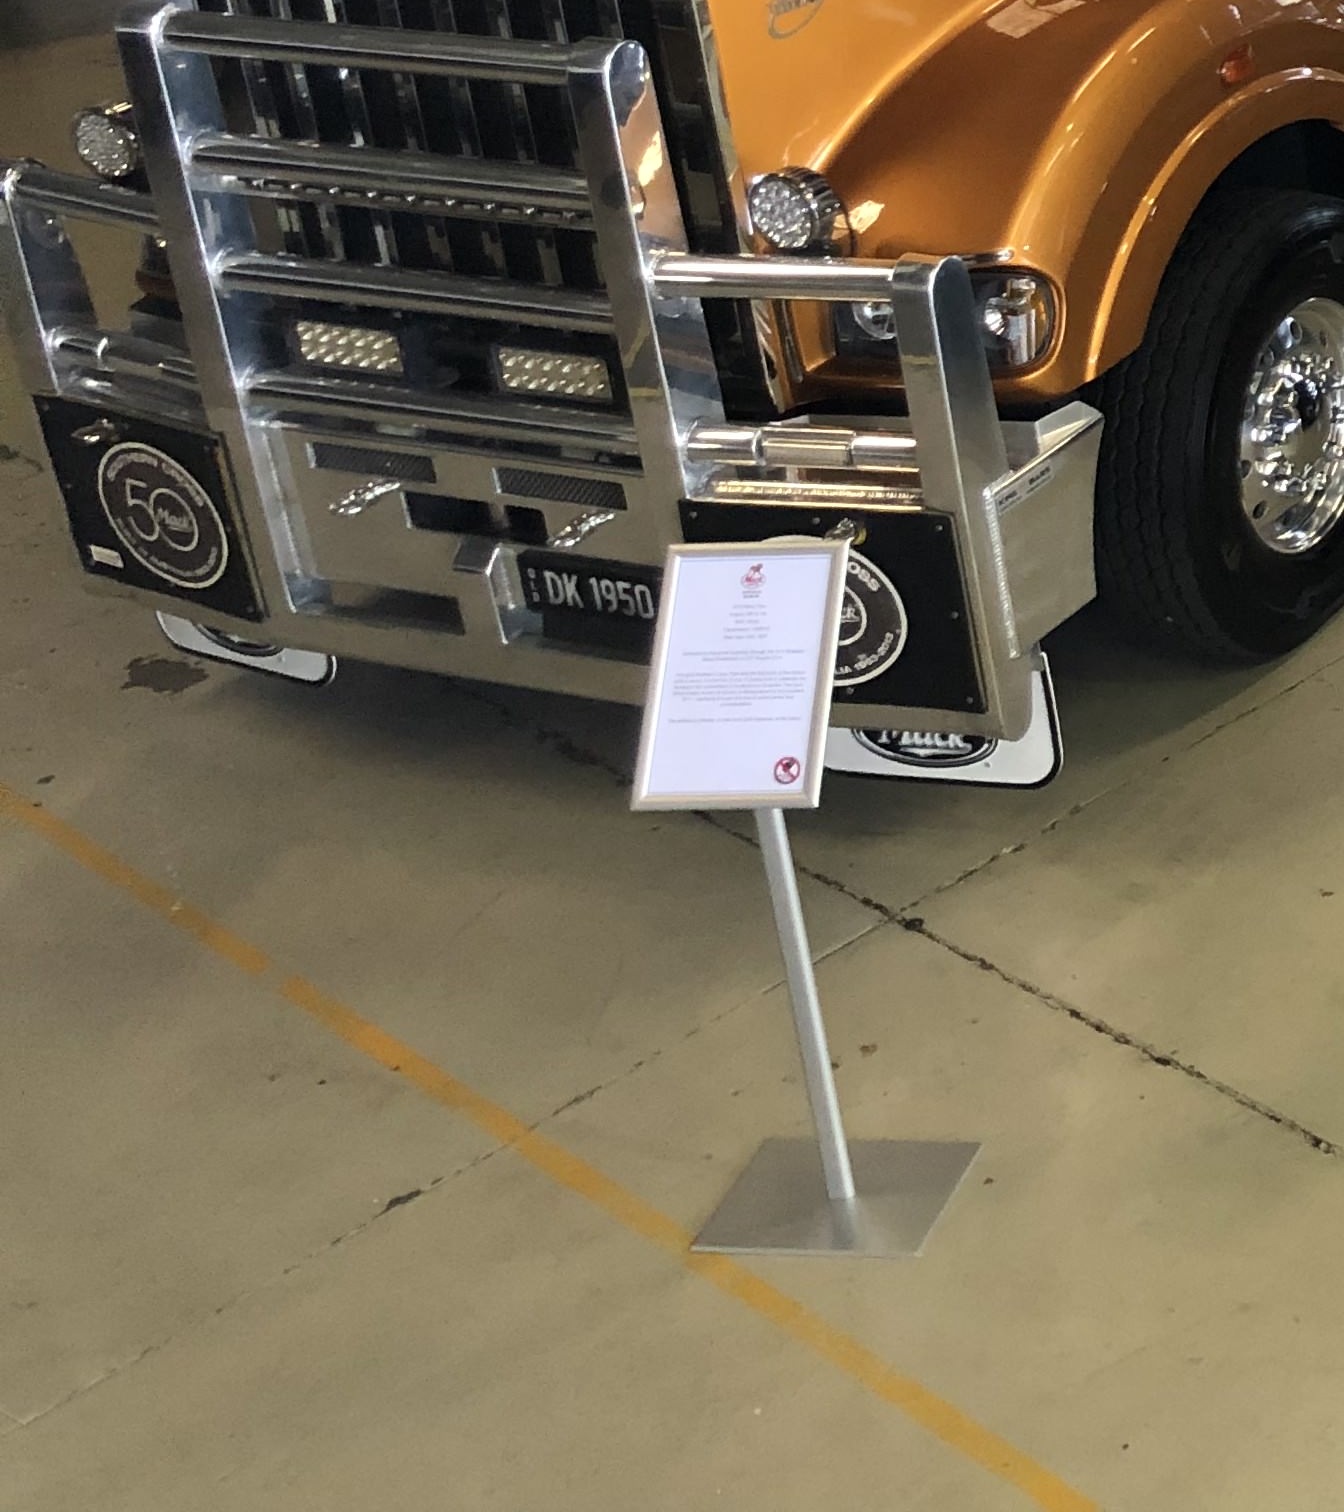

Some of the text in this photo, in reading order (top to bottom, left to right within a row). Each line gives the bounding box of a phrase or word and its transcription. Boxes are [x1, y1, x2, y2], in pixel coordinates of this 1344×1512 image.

[125, 477, 199, 552] 50
[543, 569, 655, 620] DK 1950
